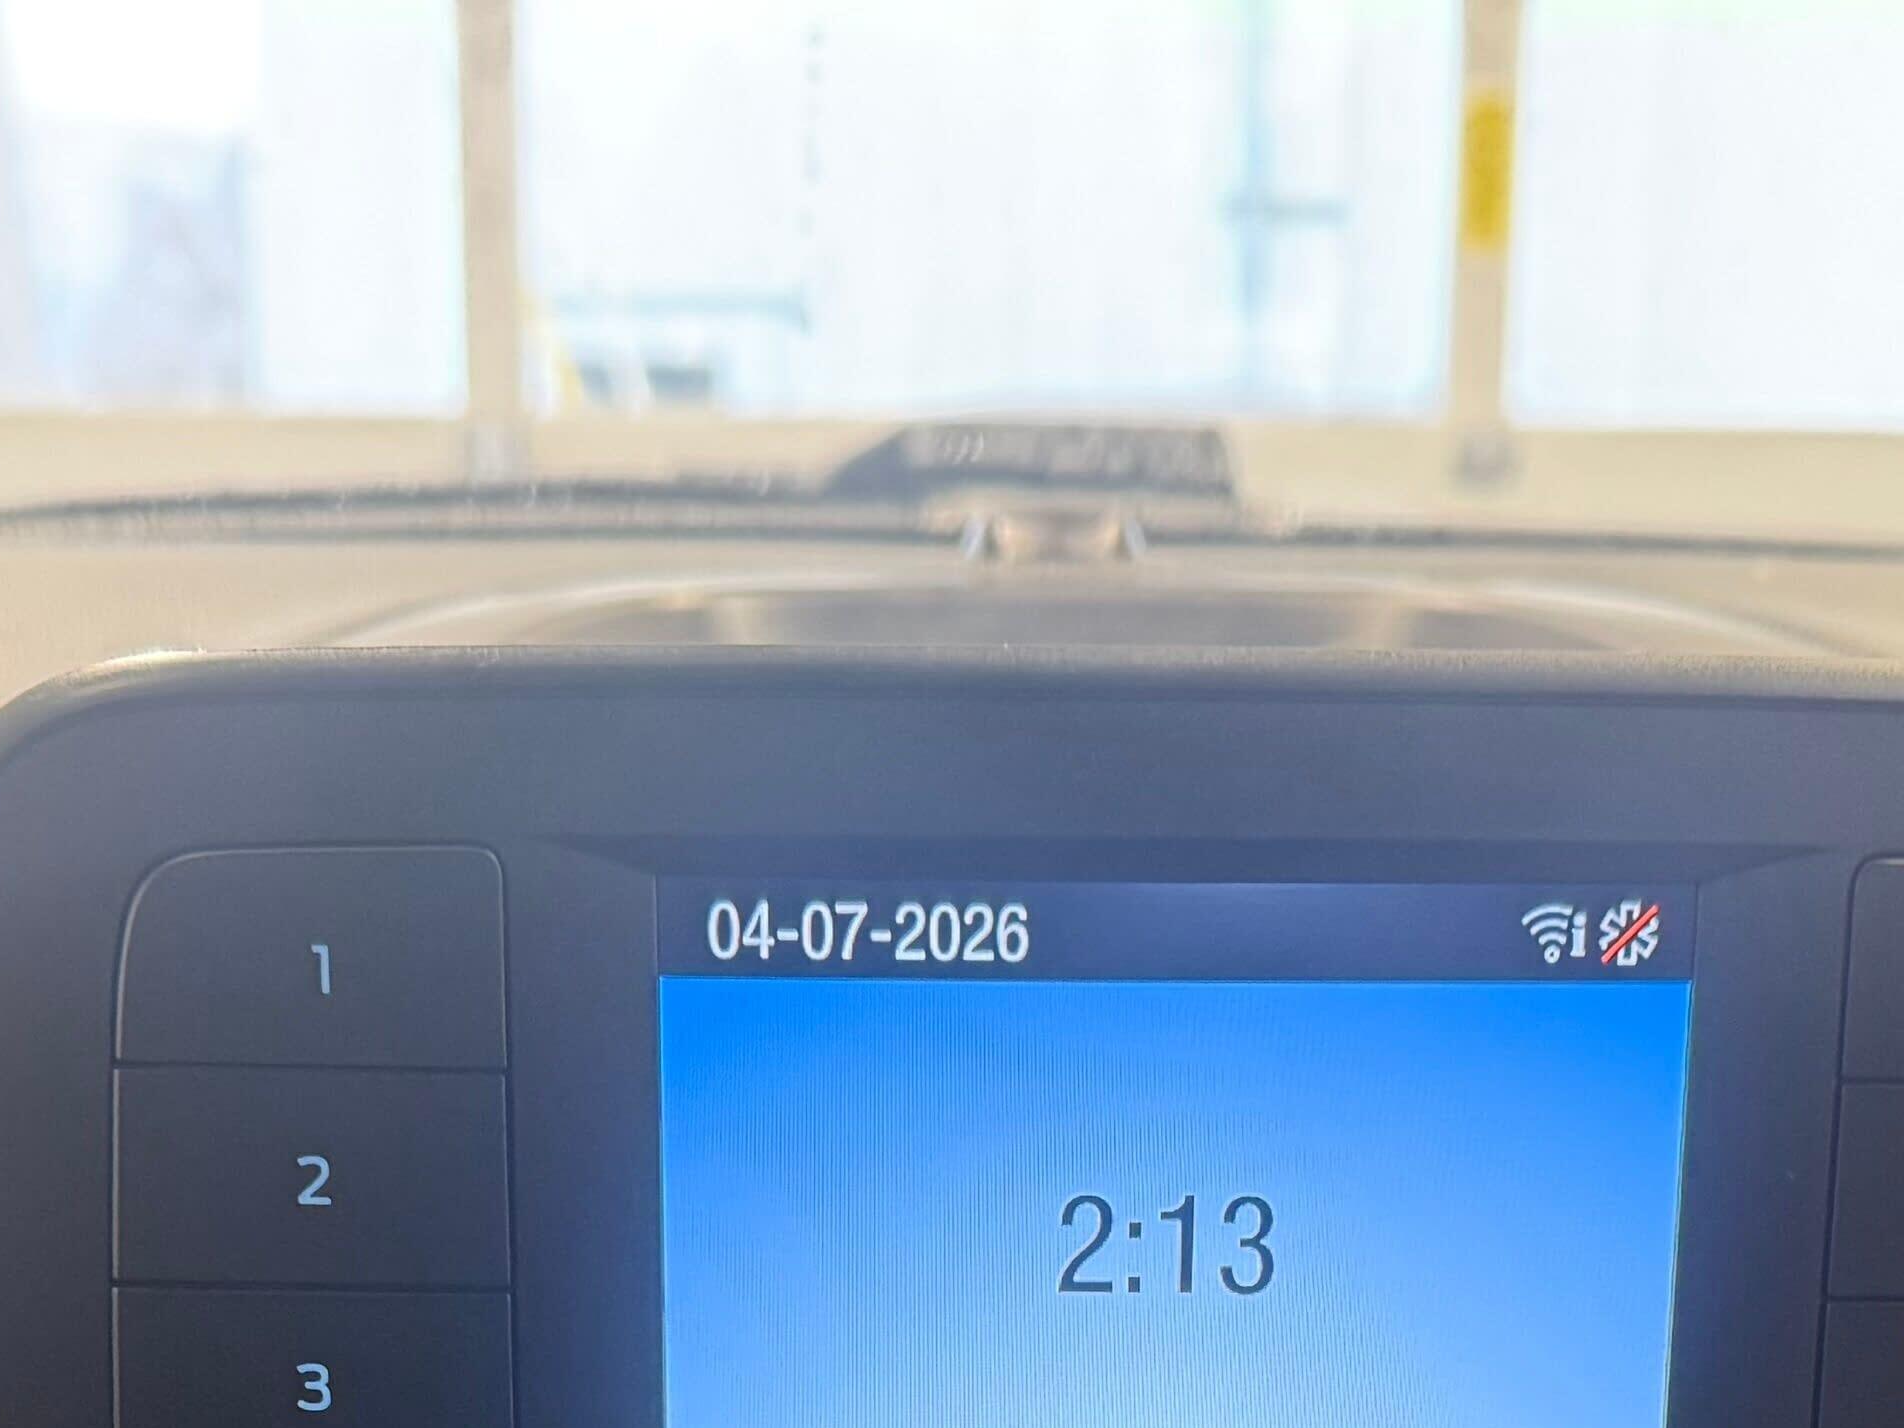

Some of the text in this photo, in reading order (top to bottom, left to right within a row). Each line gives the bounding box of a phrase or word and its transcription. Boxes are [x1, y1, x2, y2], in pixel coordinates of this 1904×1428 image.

[707, 900, 1030, 963] 04-07-2026
[309, 945, 331, 994] 1
[296, 1155, 333, 1206] 2
[1059, 1195, 1274, 1295] 2:13
[295, 1363, 333, 1412] 3
